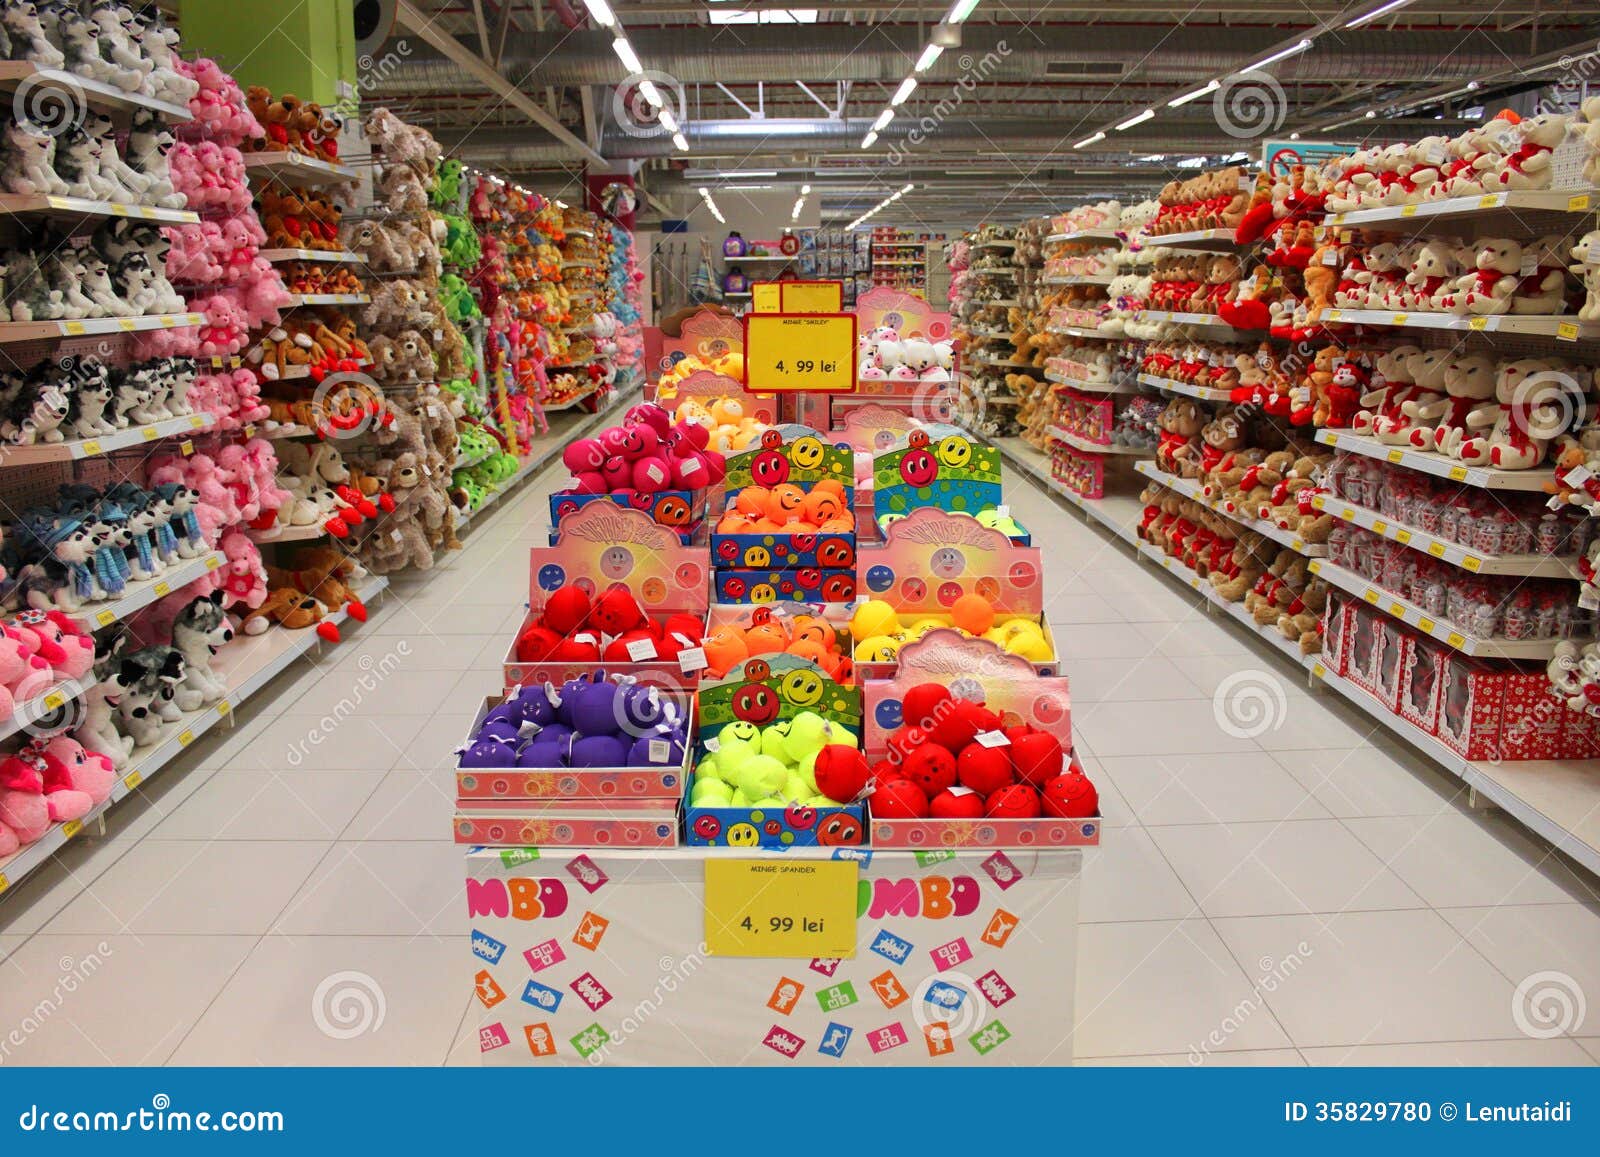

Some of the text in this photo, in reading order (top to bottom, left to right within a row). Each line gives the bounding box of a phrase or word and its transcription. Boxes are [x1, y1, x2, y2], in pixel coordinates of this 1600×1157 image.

[775, 360, 836, 374] 4, 99 lei
[741, 916, 824, 934] 4, 99 lei
